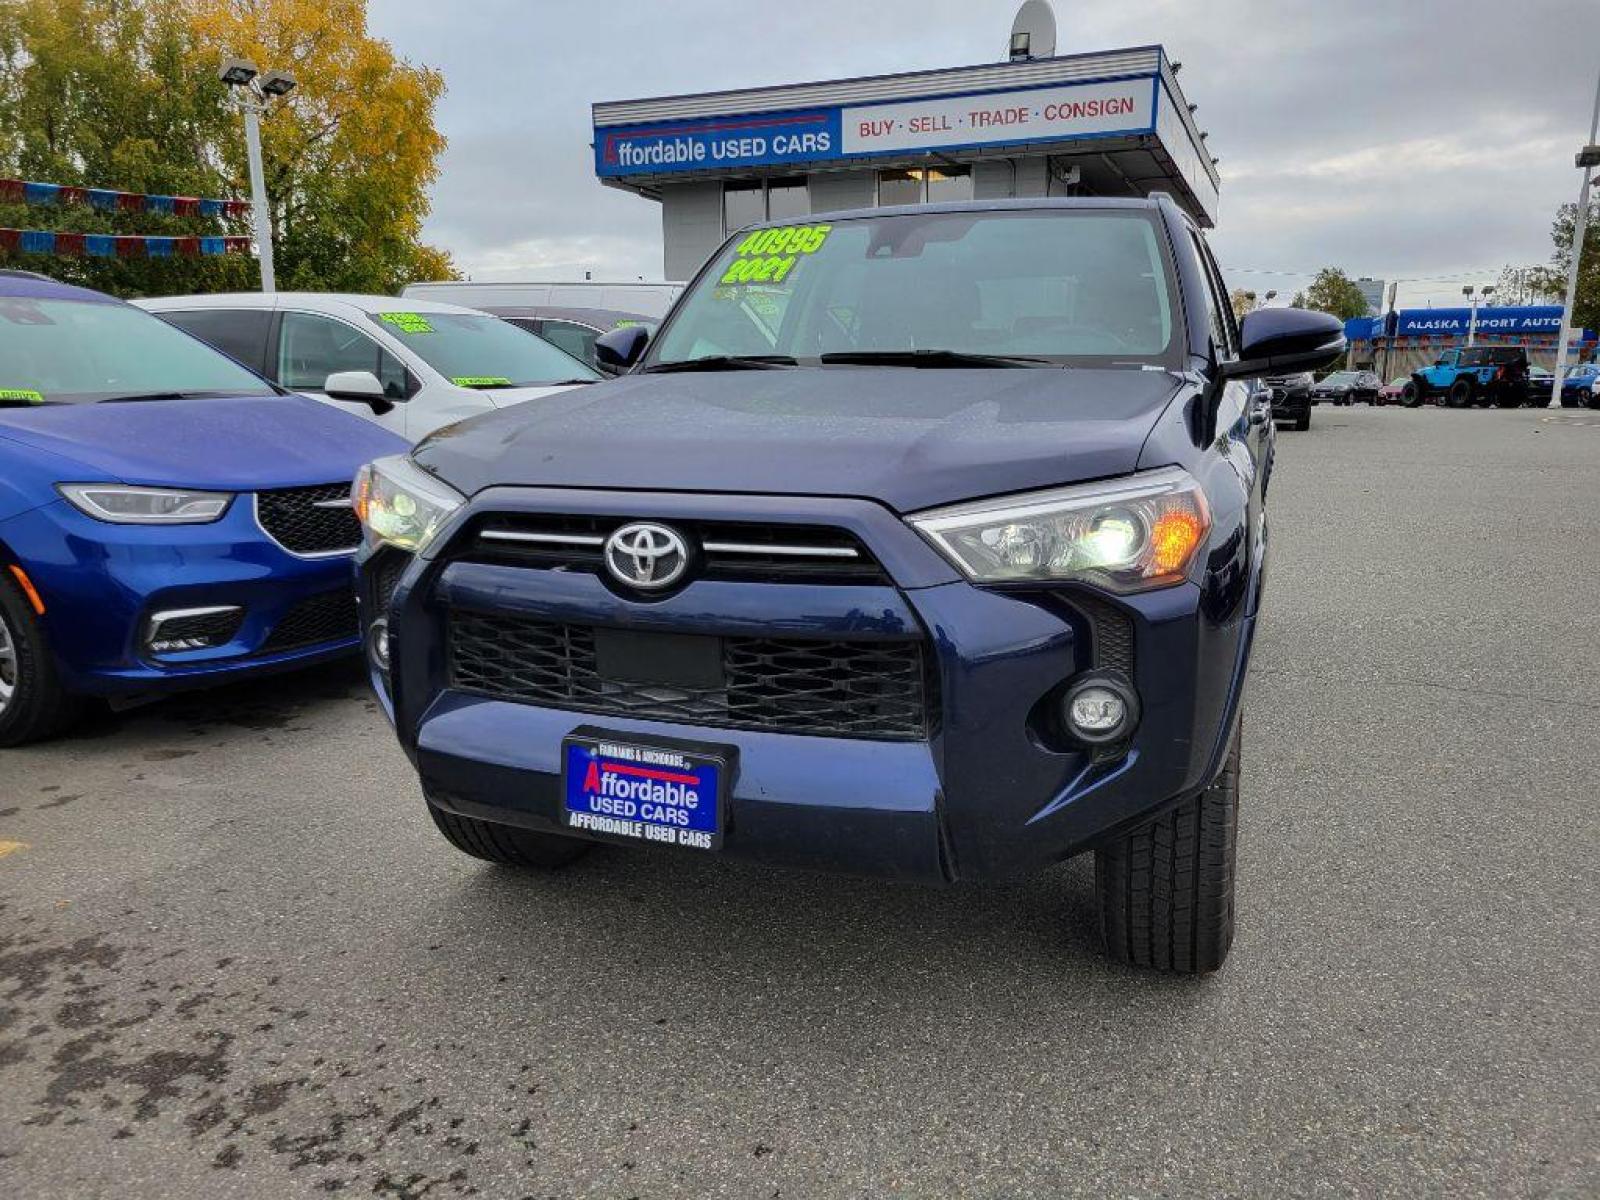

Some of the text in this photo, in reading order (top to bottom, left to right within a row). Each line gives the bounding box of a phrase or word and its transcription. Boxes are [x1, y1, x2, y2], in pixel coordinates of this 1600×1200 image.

[859, 97, 1134, 137] BUY SELL TRADE CONSIGN
[604, 132, 830, 166] Affordable USED CARS
[721, 256, 796, 284] 2021
[1407, 319, 1459, 329] ALASKA
[1522, 317, 1561, 327] AUTO
[584, 760, 699, 809] Affordable
[590, 796, 689, 826] USED CARS
[569, 812, 712, 849] AFFORDABLE USED CARS
